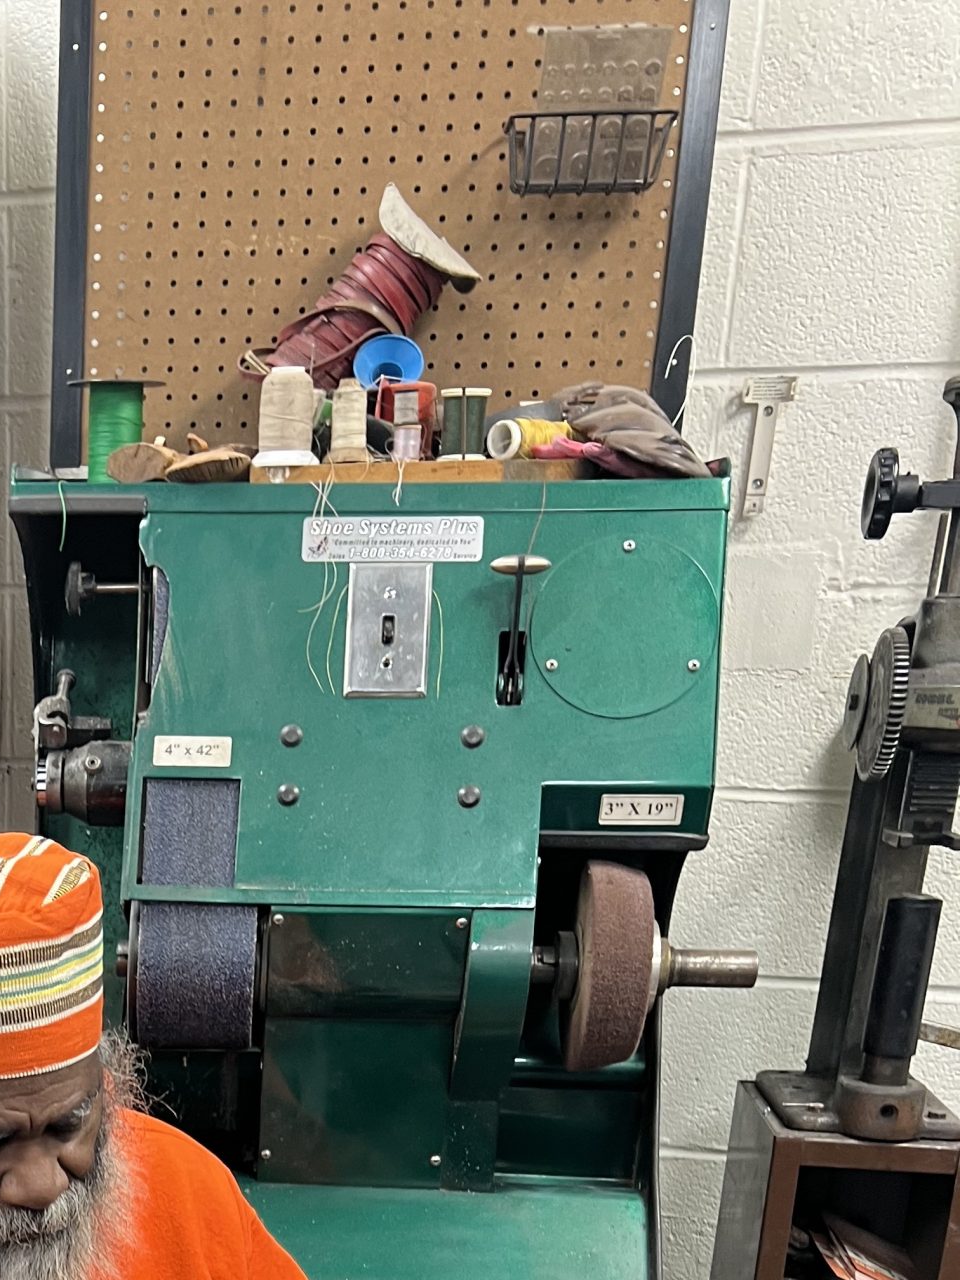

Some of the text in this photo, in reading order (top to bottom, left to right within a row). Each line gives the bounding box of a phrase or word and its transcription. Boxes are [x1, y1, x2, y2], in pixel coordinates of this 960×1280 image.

[310, 519, 478, 538] Shoe Systems Plus
[349, 546, 453, 560] 1-800-354-6278
[165, 743, 220, 756] 4" x 42"
[628, 802, 640, 816] X
